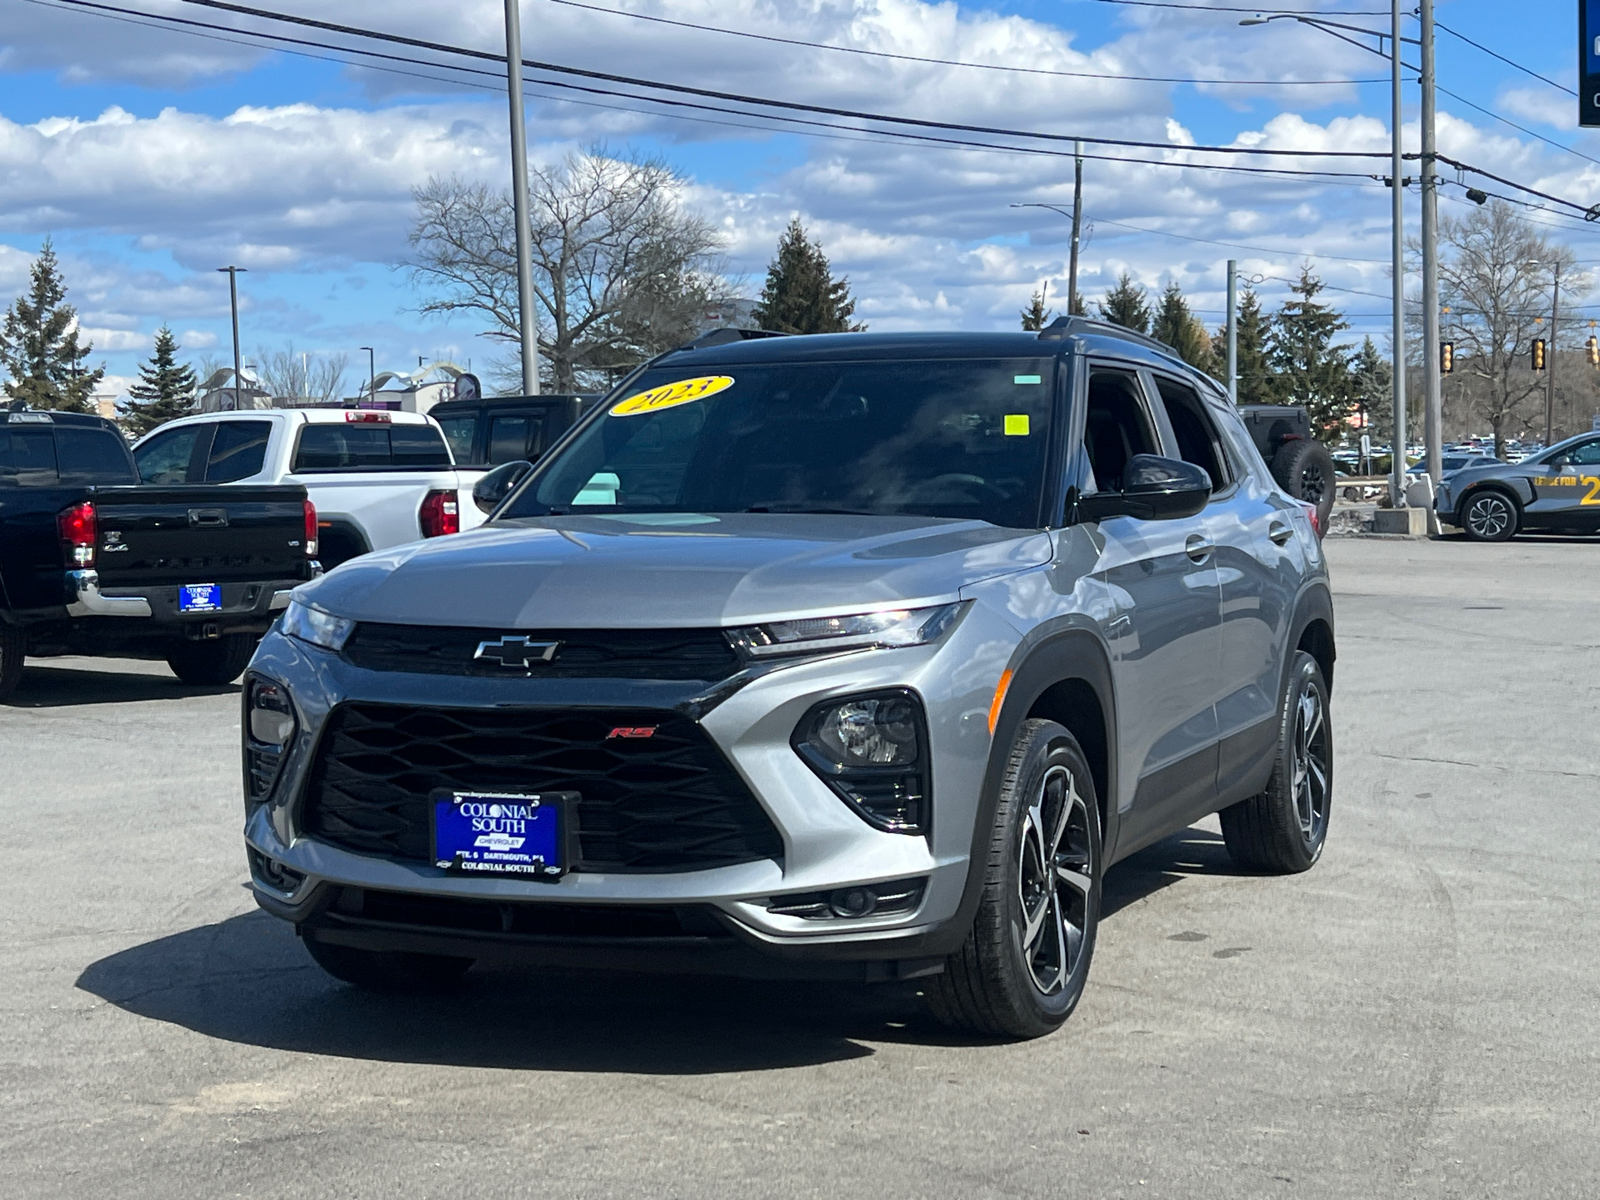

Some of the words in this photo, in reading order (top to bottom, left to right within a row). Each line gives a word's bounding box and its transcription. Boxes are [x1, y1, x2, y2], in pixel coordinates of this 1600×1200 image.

[626, 379, 714, 412] 2023
[1560, 476, 1577, 486] FOR
[606, 726, 657, 739] RS
[460, 802, 539, 820] COLONIAL
[471, 817, 526, 833] SOUTH
[461, 861, 505, 872] COLONIAL
[505, 864, 535, 873] SOUTH
